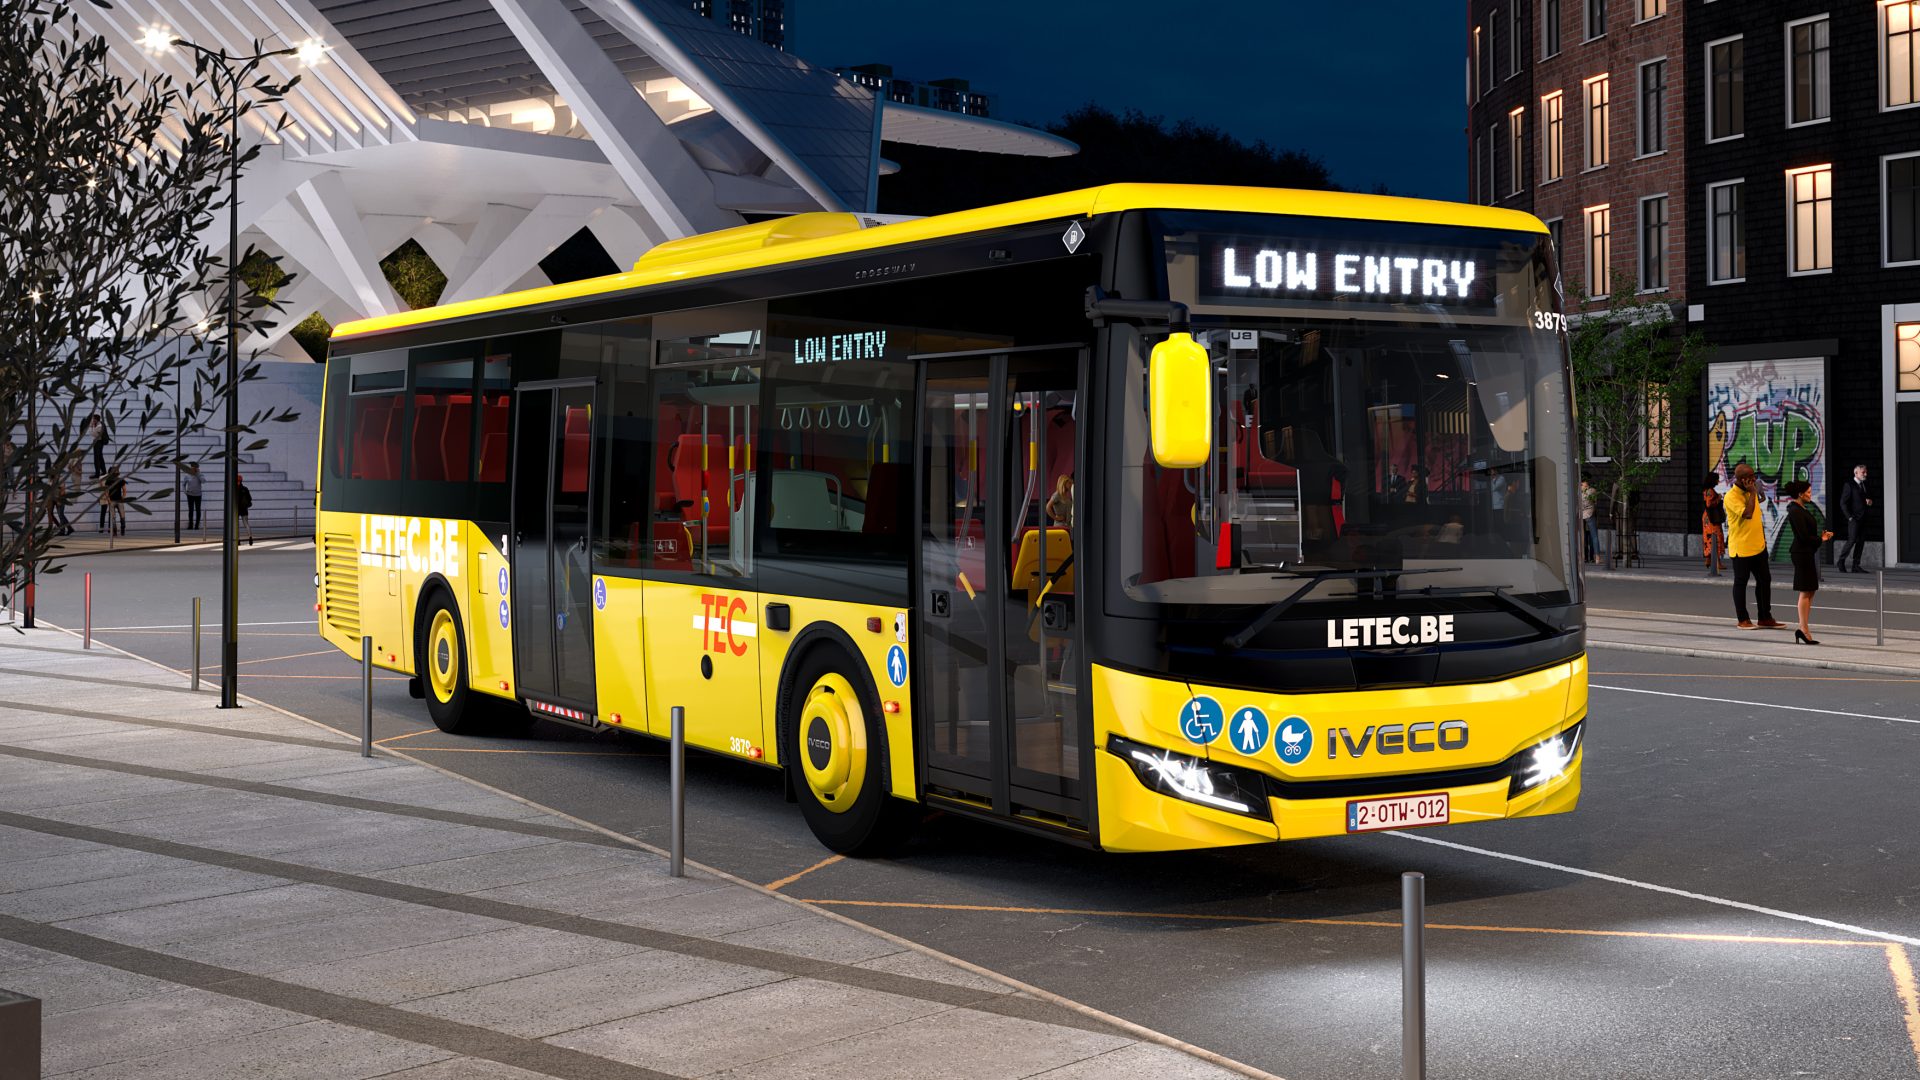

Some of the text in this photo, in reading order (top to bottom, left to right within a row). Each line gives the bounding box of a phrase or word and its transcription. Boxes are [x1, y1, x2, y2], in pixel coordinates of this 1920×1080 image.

[855, 263, 915, 279] CROSSWAY
[1224, 247, 1476, 298] LOW ENTRY
[1534, 311, 1568, 332] 3879
[795, 330, 886, 364] LOW ENTRY
[360, 514, 459, 577] LETEC.BE
[701, 593, 748, 657] TEC
[1327, 614, 1455, 648] LETEC.BE
[730, 735, 751, 756] 3879
[808, 737, 831, 750] IVECO
[1327, 719, 1469, 760] IVECO
[1358, 798, 1446, 826] 2-OTW-012
